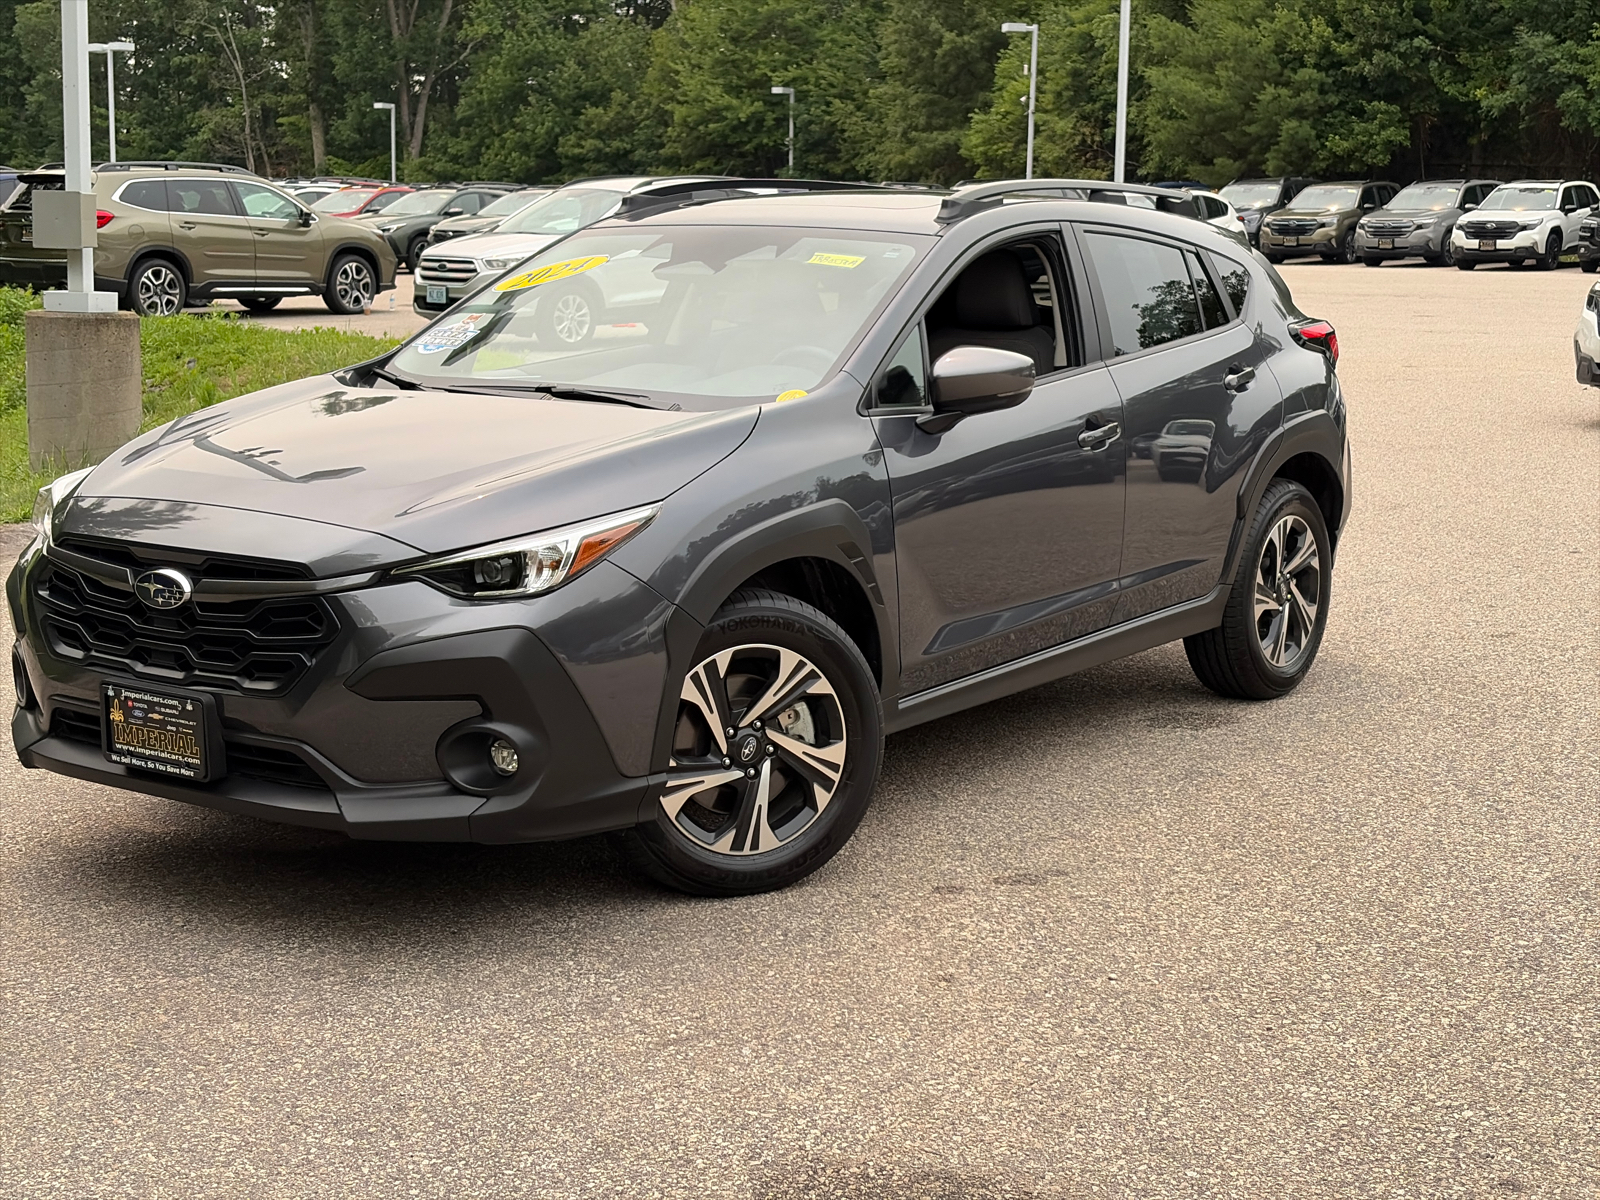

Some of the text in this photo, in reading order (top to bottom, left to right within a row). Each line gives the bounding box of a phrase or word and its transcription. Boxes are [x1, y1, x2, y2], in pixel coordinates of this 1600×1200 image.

[506, 257, 595, 290] 2024
[716, 615, 806, 636] YOKOHAMA
[160, 707, 179, 715] SUBARU
[165, 716, 197, 726] CHEVROLET
[114, 722, 200, 758] IMPERIAL
[115, 743, 201, 764] www.imperialcars.com
[111, 754, 194, 777] We Sell More, So You Save More
